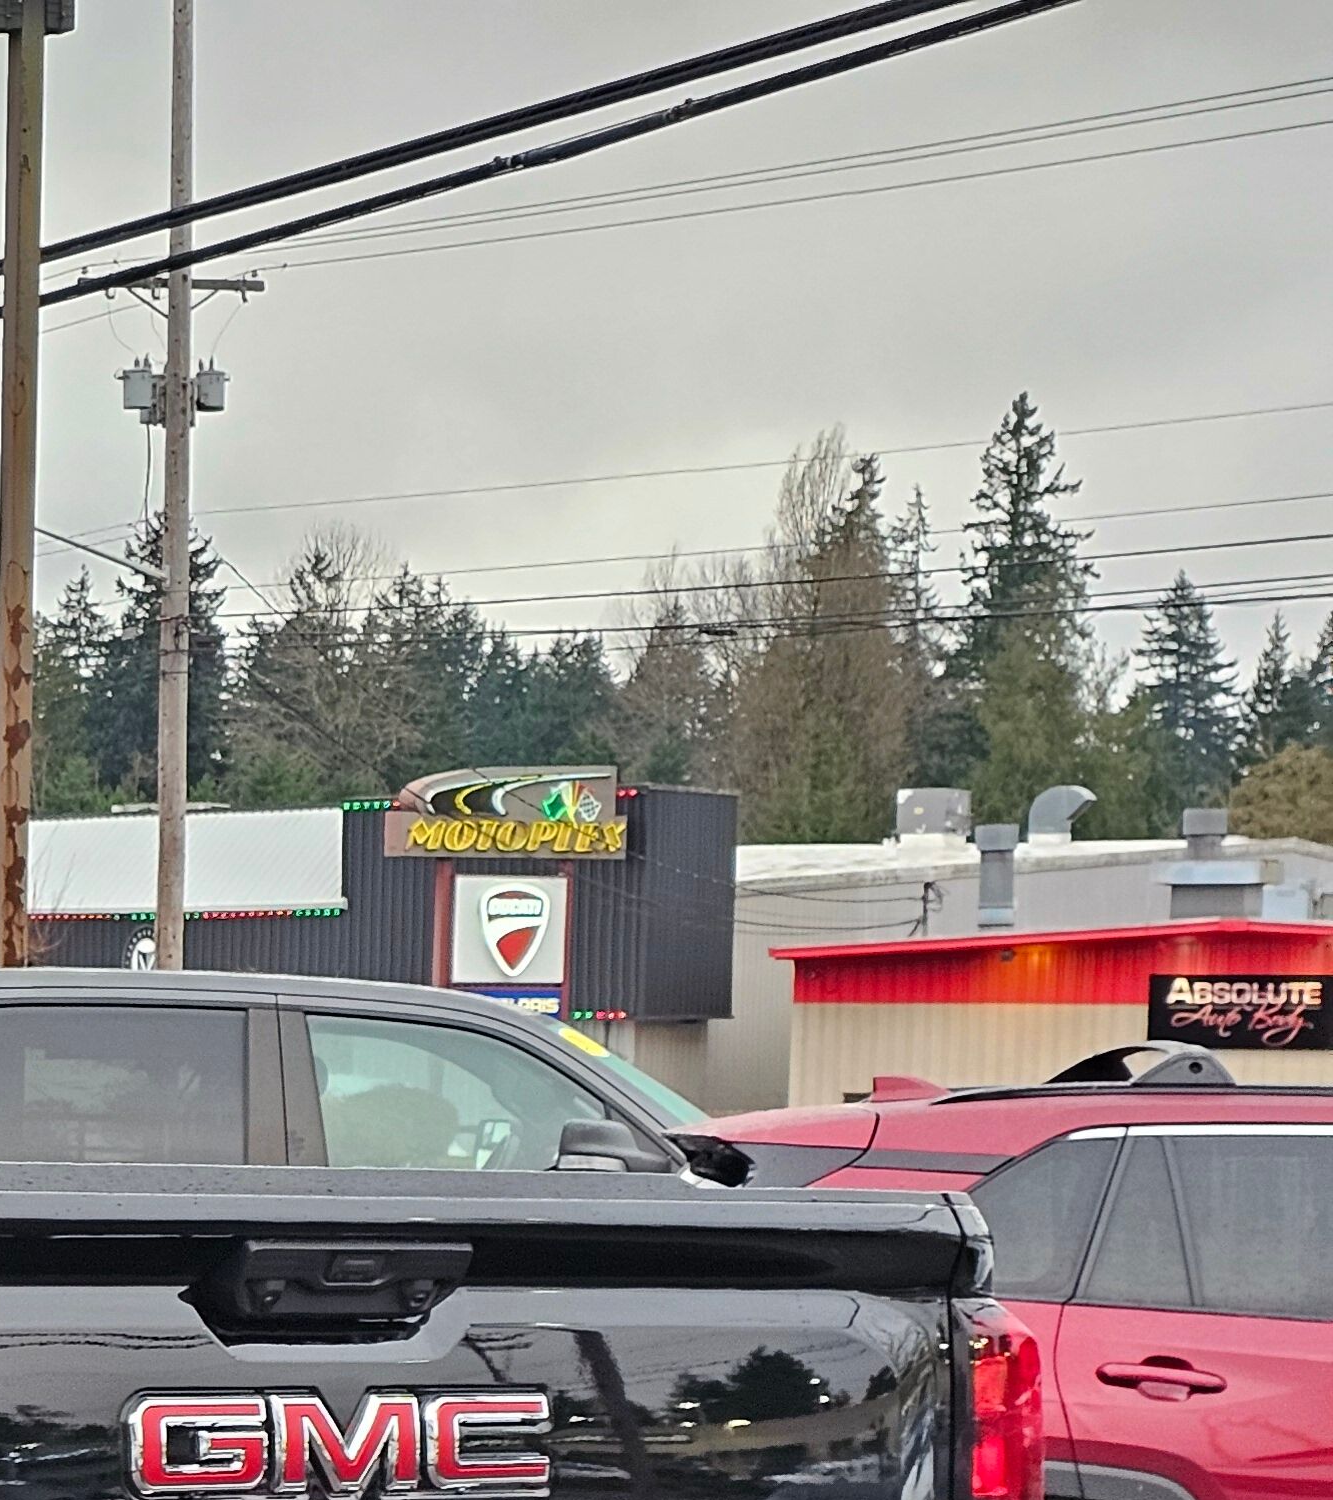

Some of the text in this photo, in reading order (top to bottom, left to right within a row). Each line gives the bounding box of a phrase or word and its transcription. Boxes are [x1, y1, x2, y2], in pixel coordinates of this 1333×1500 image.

[405, 817, 626, 853] MOTOPLEX
[1166, 977, 1324, 1005] ABSOLUTE
[1171, 1003, 1314, 1047] Auto Body
[128, 1390, 552, 1500] GMC
